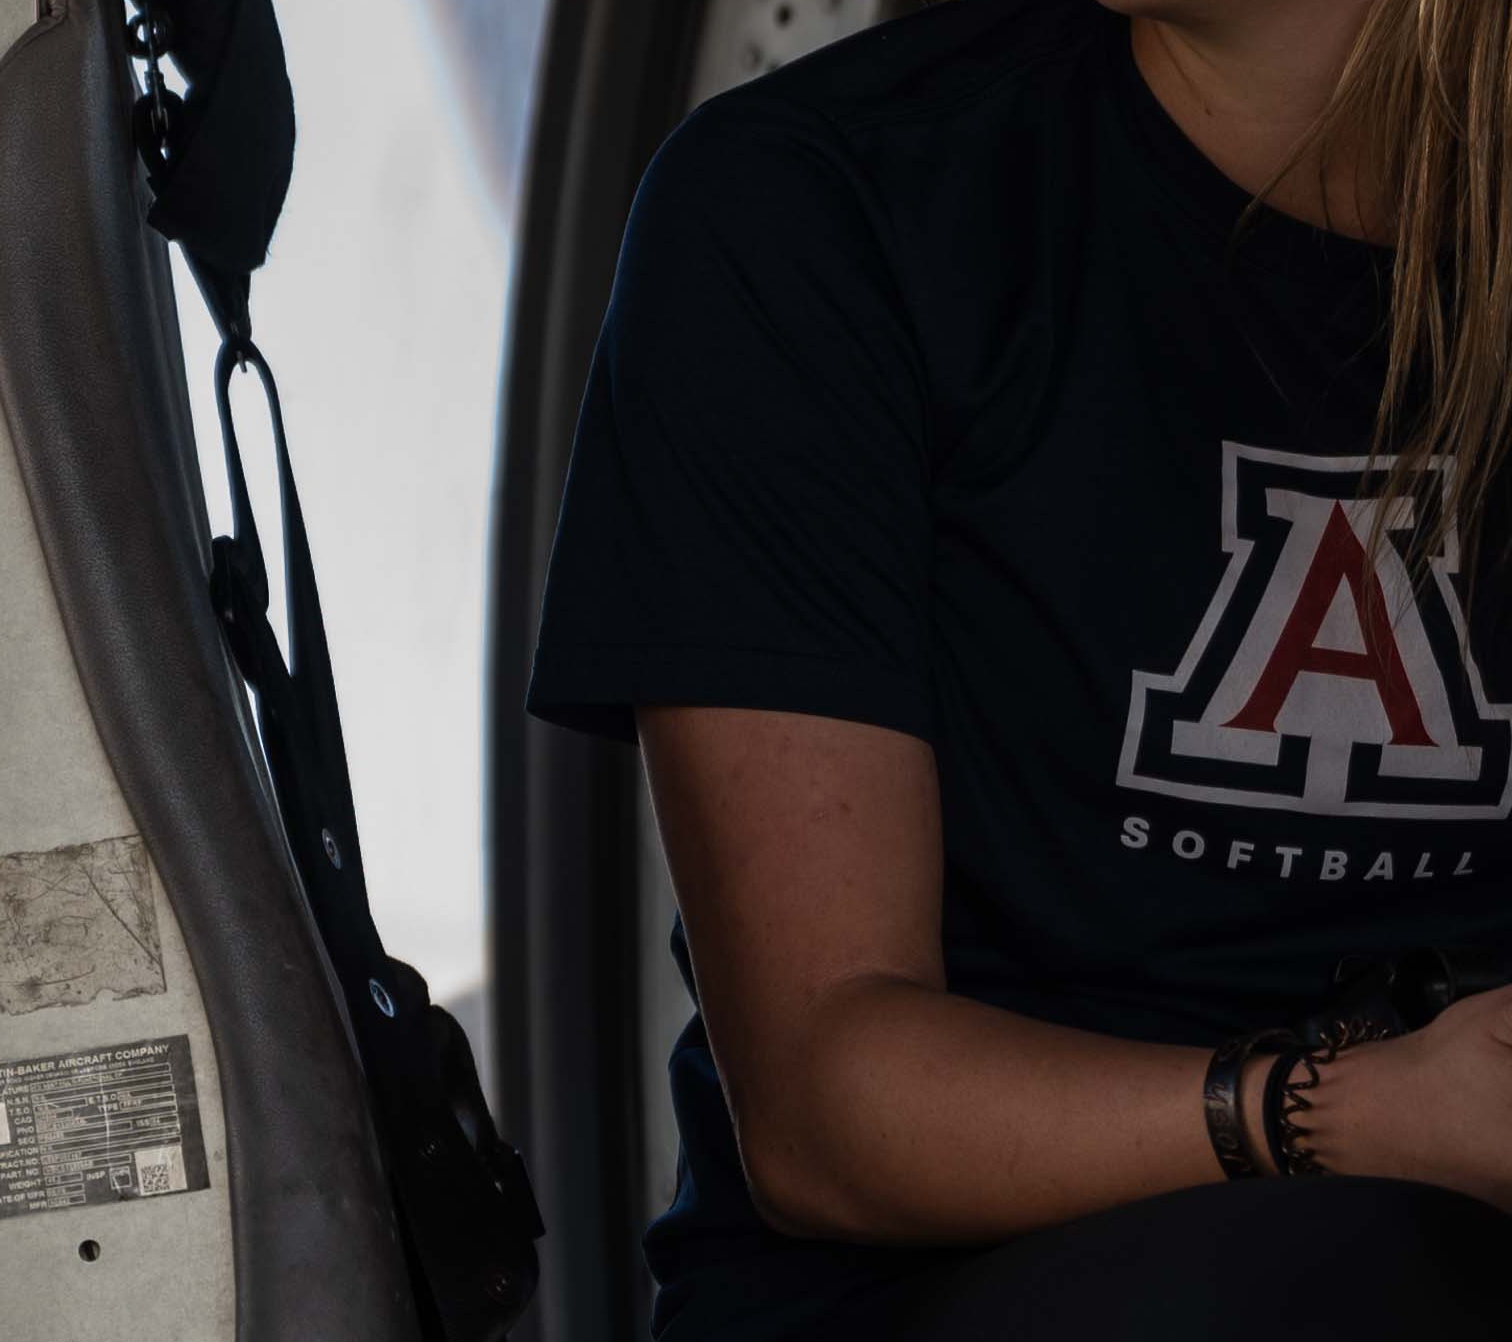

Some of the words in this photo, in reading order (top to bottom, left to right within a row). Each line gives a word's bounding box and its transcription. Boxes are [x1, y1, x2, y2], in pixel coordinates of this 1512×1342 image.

[1119, 815, 1476, 882] SOFTBALL
[58, 1052, 113, 1068] AIRCRAFT
[114, 1044, 170, 1060] COMPANY
[8, 1178, 42, 1191] WEIGHT
[13, 1192, 26, 1203] OF
